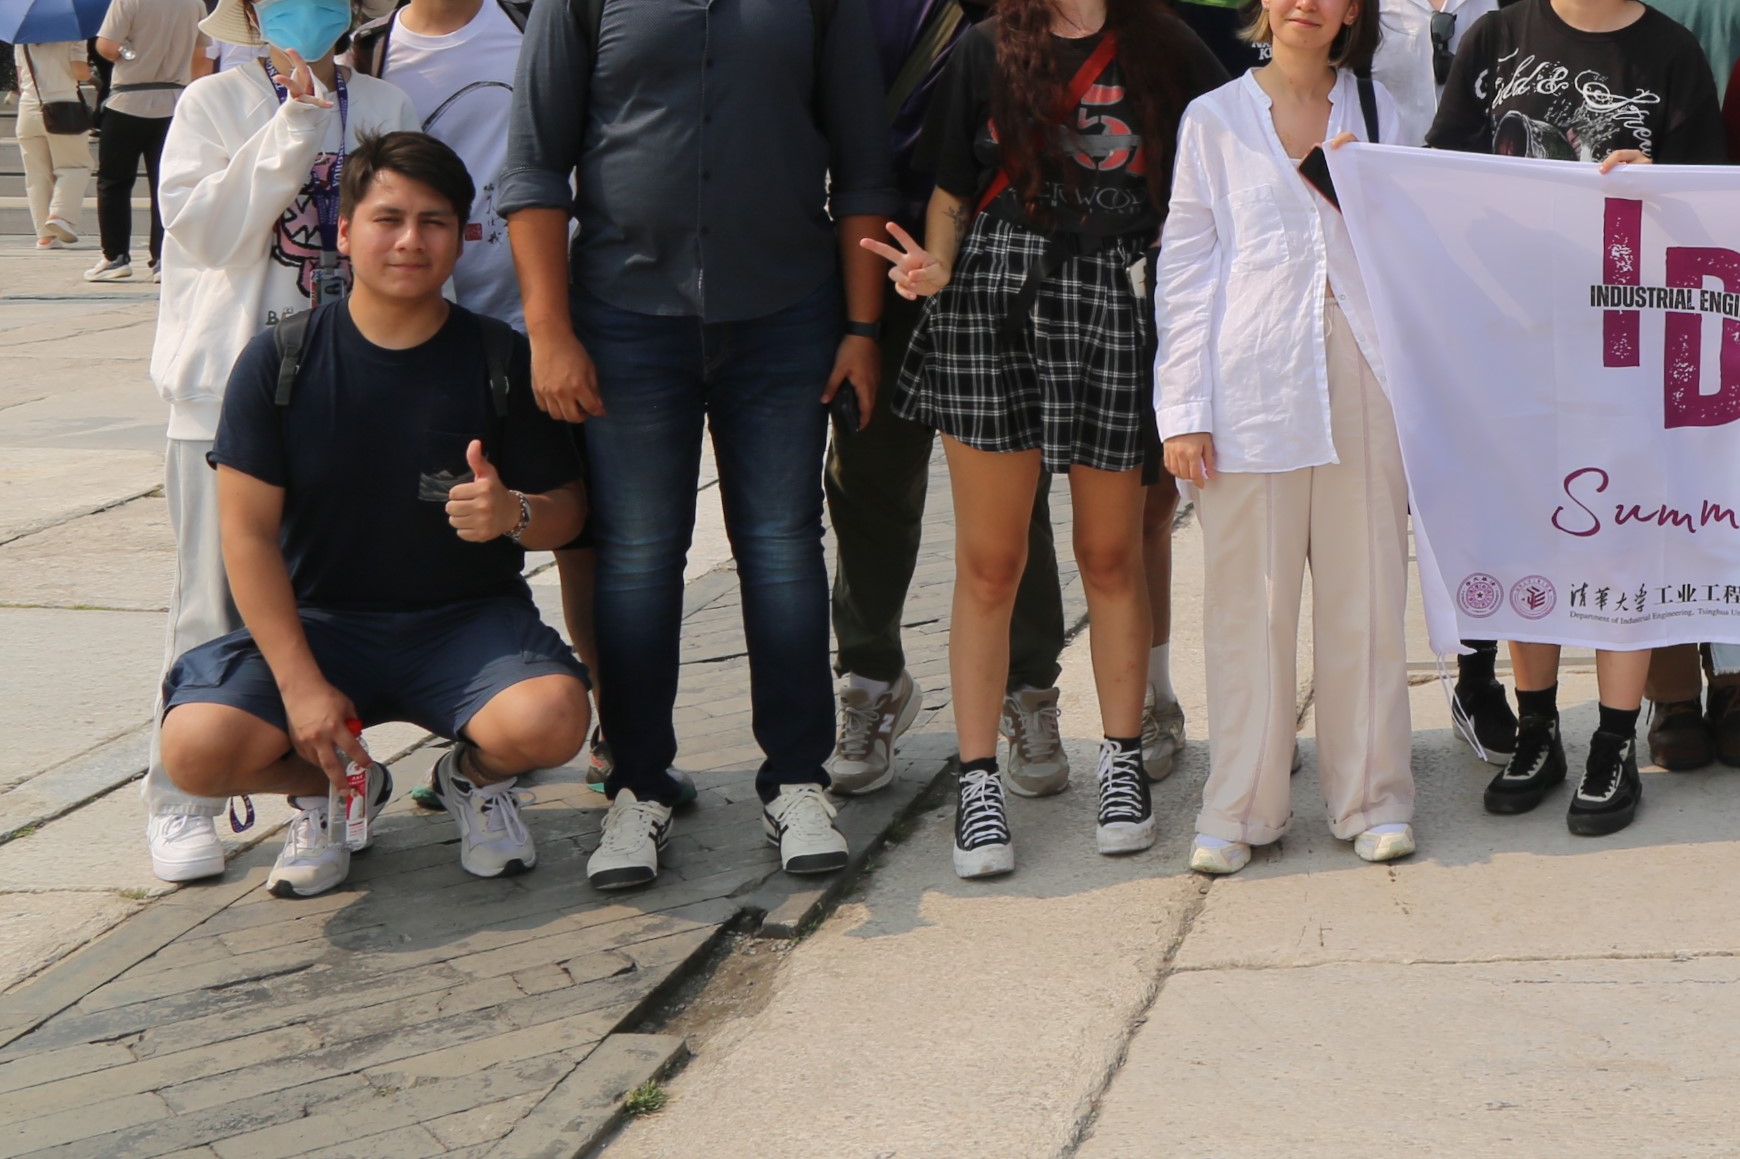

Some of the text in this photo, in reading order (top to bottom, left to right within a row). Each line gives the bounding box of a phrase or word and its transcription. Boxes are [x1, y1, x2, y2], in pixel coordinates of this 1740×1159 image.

[1589, 284, 1696, 311] INDUSTRIAL
[1569, 610, 1610, 624] Department
[1611, 616, 1619, 625] of
[1620, 614, 1651, 626] Industrial
[1652, 610, 1695, 621] Engineering,
[1698, 607, 1730, 618] Tsinghua
